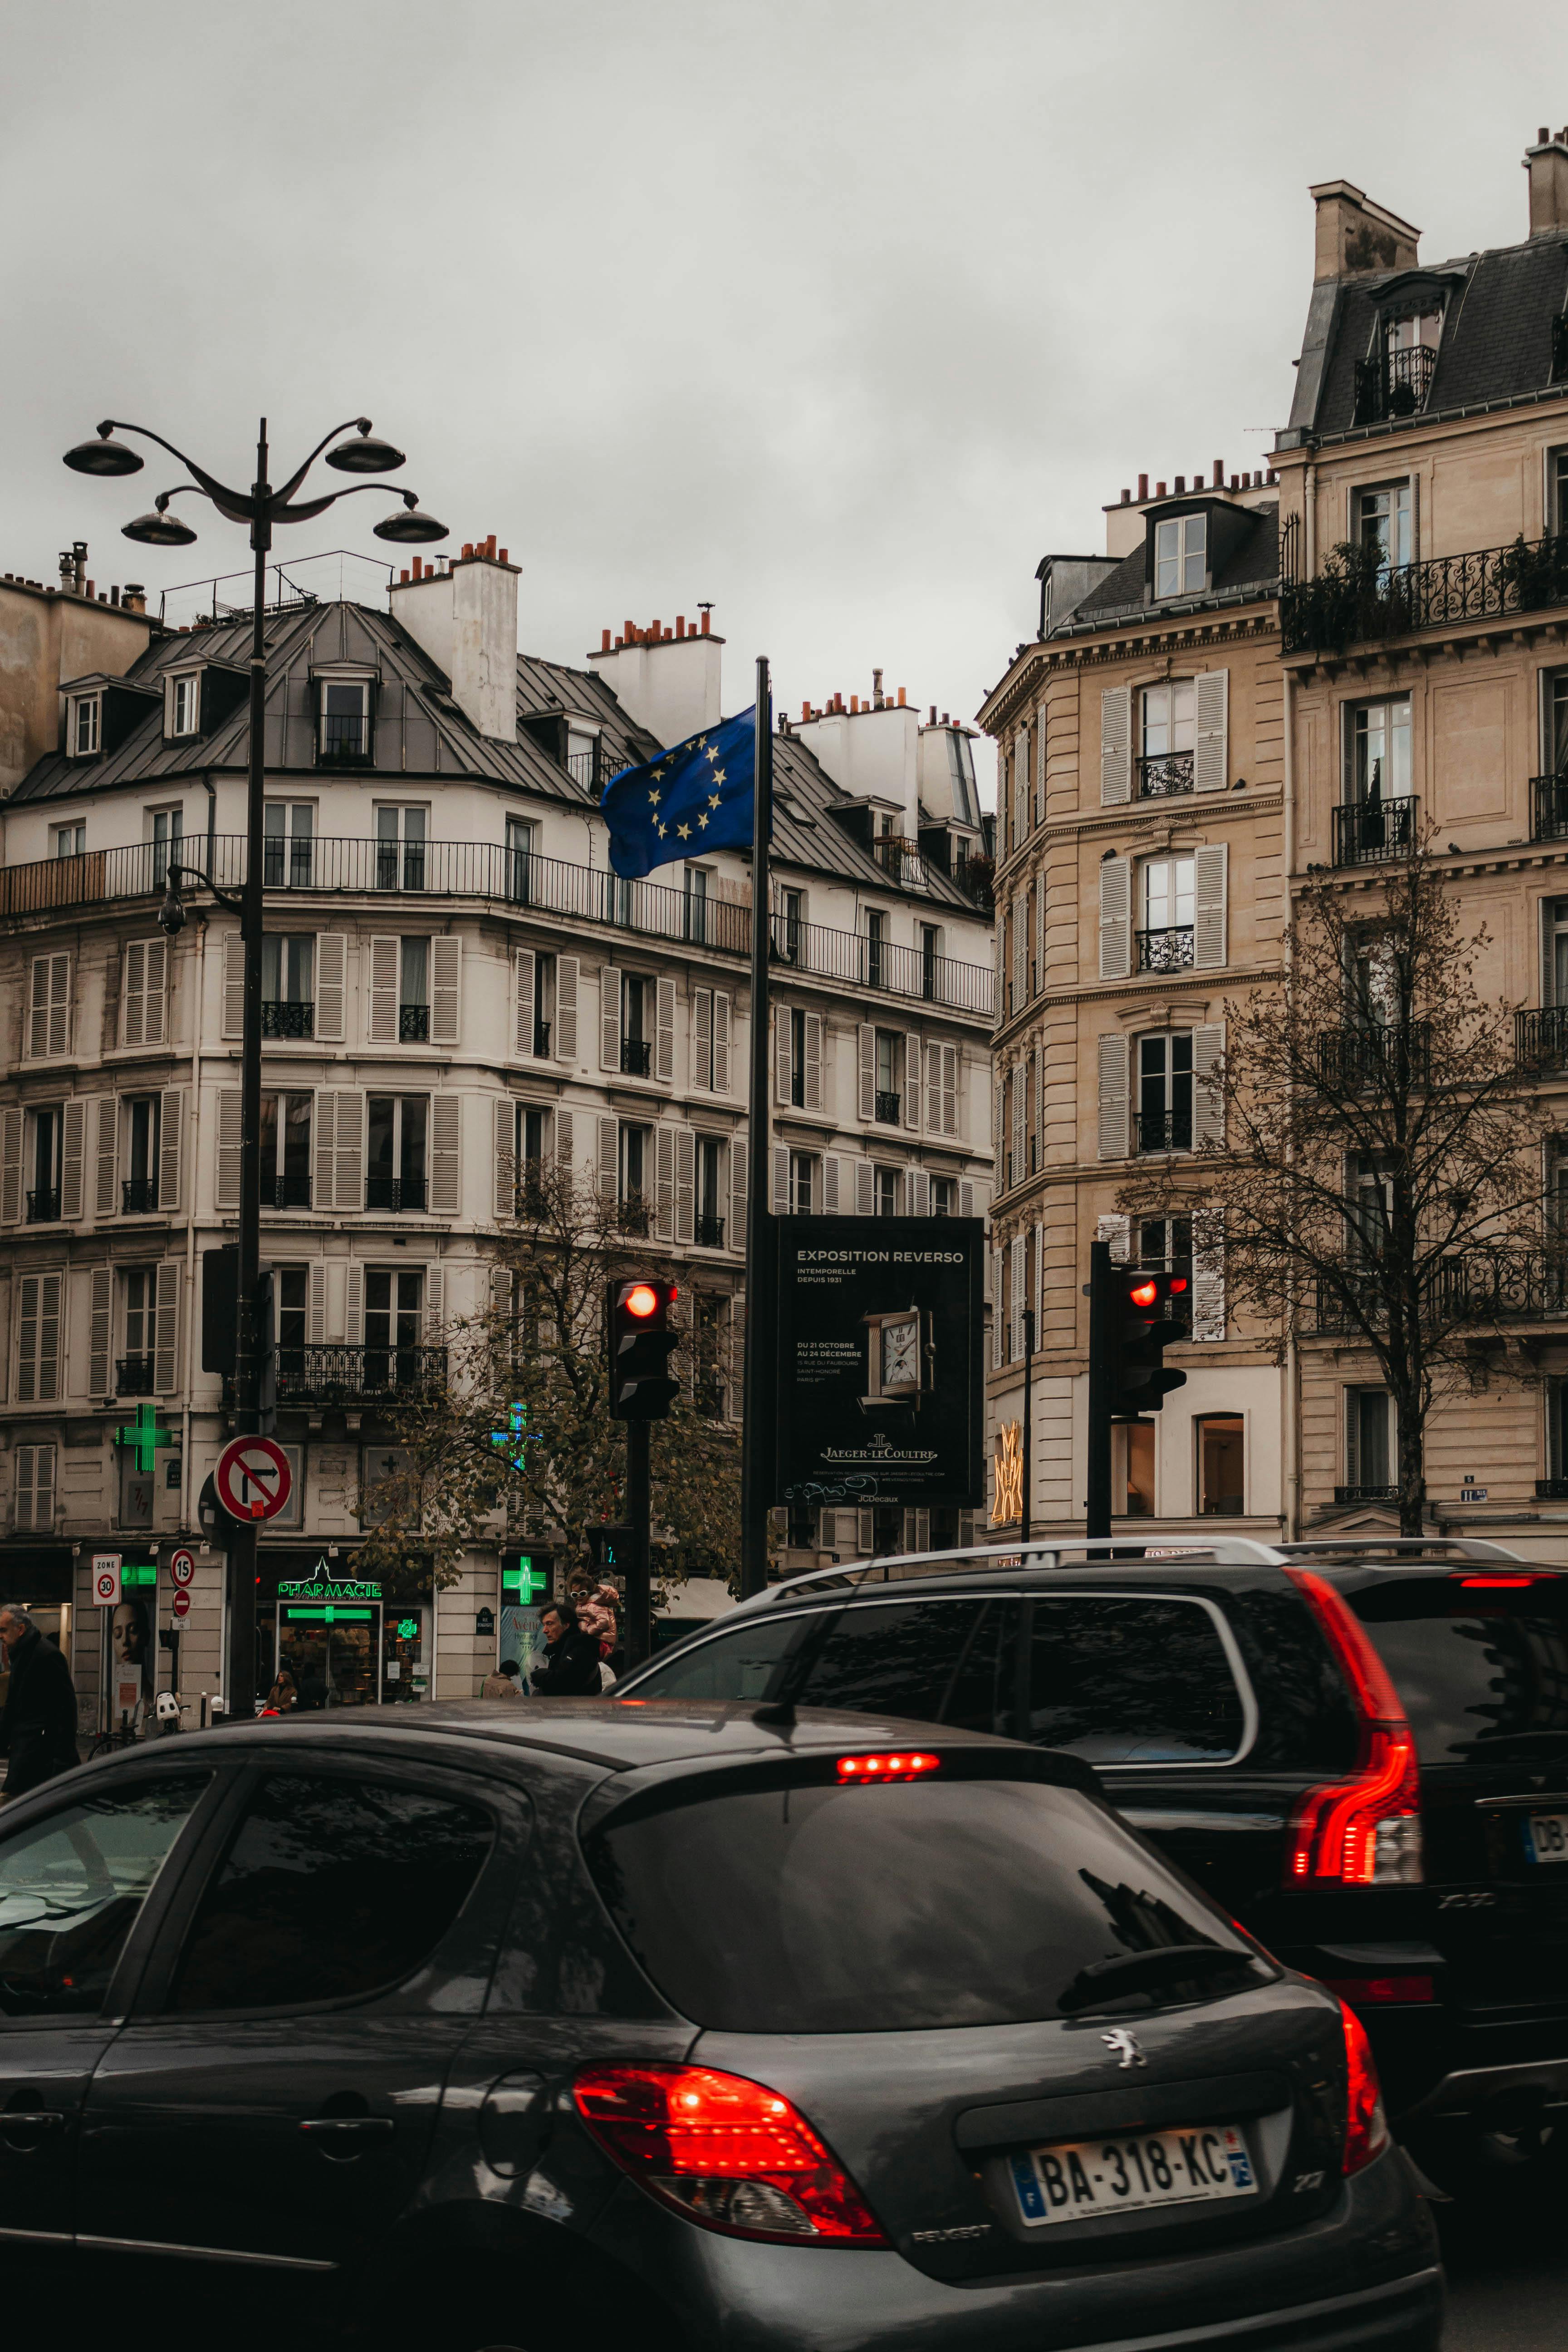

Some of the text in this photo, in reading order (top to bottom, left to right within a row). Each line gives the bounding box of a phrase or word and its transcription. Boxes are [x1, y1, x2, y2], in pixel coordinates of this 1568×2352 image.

[797, 1250, 964, 1263] EXPOSITION REVERSO
[177, 1561, 189, 1577] 15
[101, 1581, 111, 1592] 30
[278, 1583, 382, 1597] PHARMACIE
[1026, 2192, 1035, 2206] F
[1038, 2133, 1228, 2207] BA-318-KC
[911, 2225, 993, 2243] PEUGEOT
